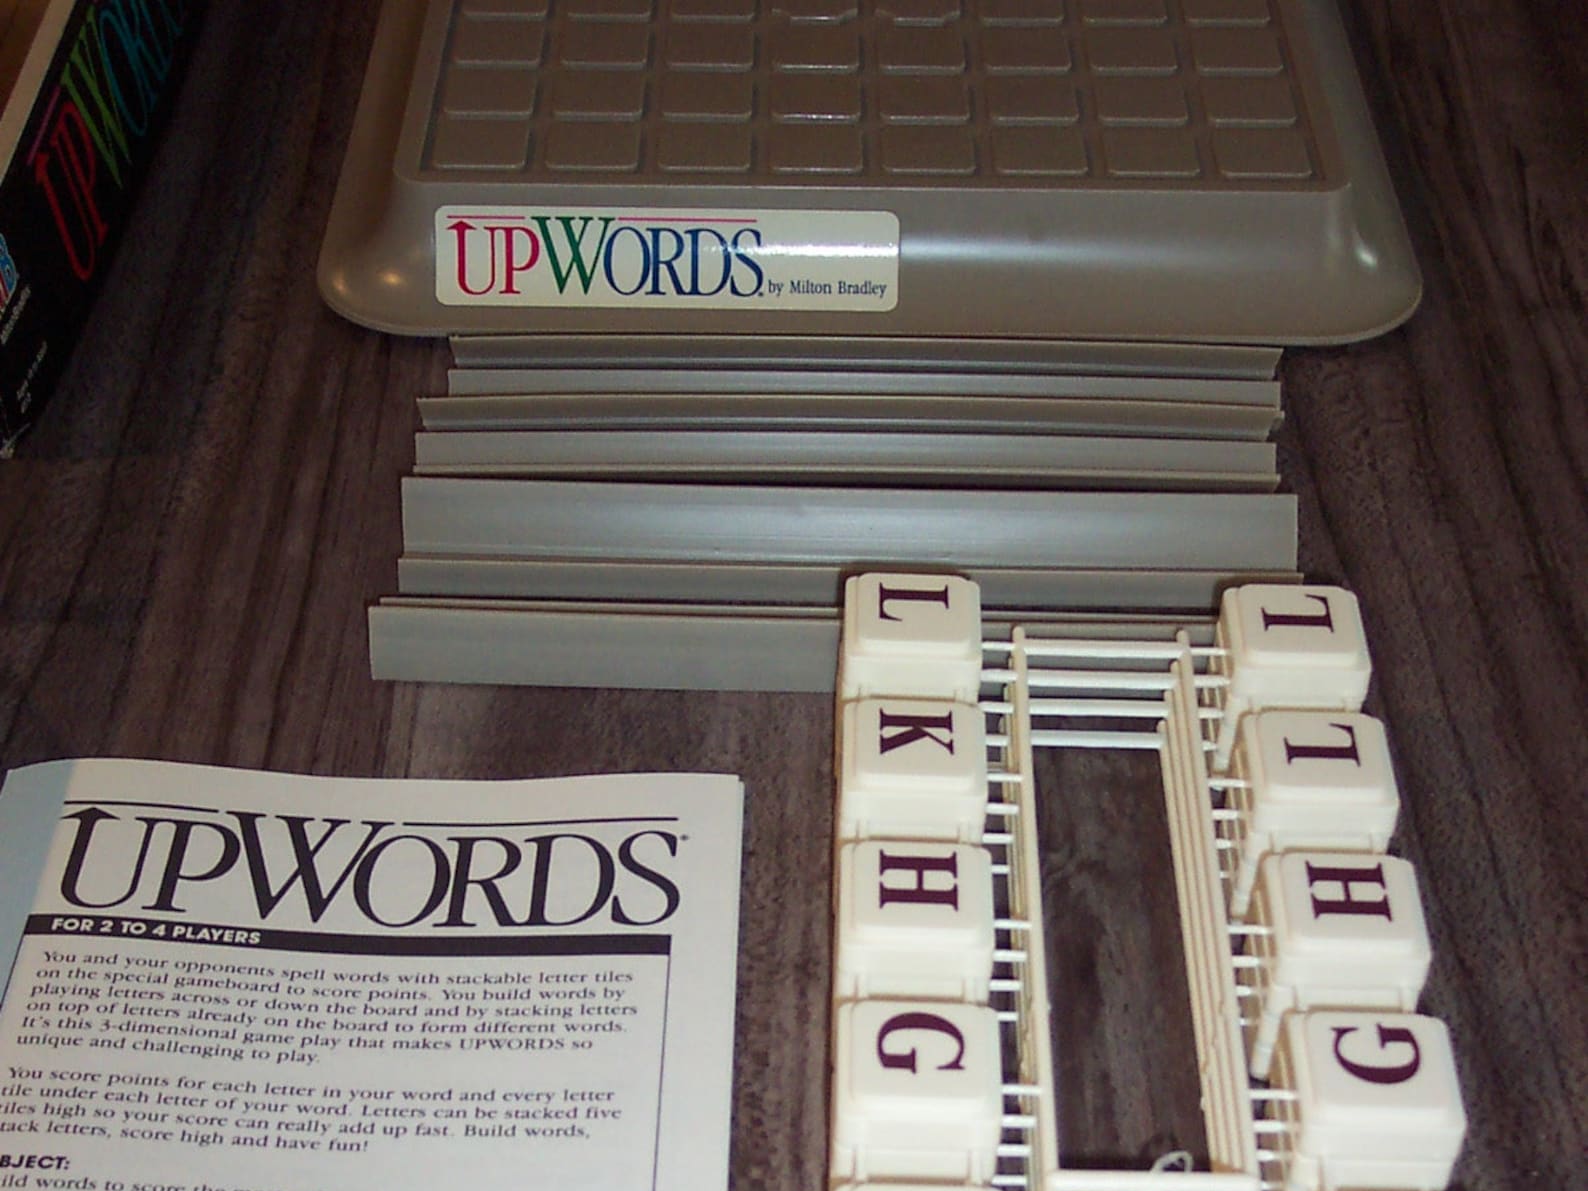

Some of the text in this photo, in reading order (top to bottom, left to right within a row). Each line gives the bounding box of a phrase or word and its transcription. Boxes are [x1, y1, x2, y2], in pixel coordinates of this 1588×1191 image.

[447, 216, 887, 298] UPWORDS by Milton Bradley
[879, 583, 948, 620] L
[1262, 595, 1333, 632] L
[880, 709, 954, 754] K
[1285, 724, 1360, 765] L
[60, 807, 680, 928] UPWORDS
[880, 850, 958, 910] H
[1306, 862, 1392, 921] H
[51, 917, 262, 945] FOR 2 TO 4 PLAYERS
[36, 965, 625, 1003] on the special gameboard score points. You build words by
[44, 948, 633, 984] You and your opponents spell words with stackable letter tiles
[26, 1000, 626, 1033] on top of letters already on the board form different words.
[30, 981, 637, 1020] playing letters across down the board and by stacking letters
[17, 1032, 319, 1068] unique and challenging play.
[57, 1015, 92, 1030] this
[242, 1031, 294, 1045] game
[300, 1032, 341, 1051] play
[349, 1034, 384, 1049] that
[393, 1035, 452, 1049] makes
[460, 1035, 564, 1049] UPWORDS
[877, 1013, 964, 1073] G
[1333, 1024, 1420, 1084] G
[1, 1082, 622, 1119] tile under each letter of your word. Letters can be stacked five
[9, 1064, 615, 1105] You score points for each letter your word and every letter
[43, 1102, 590, 1139] high so your score can really add up fast. Build words,
[46, 1120, 368, 1152] letters, score high and have fun!
[36, 1175, 96, 1189] words
